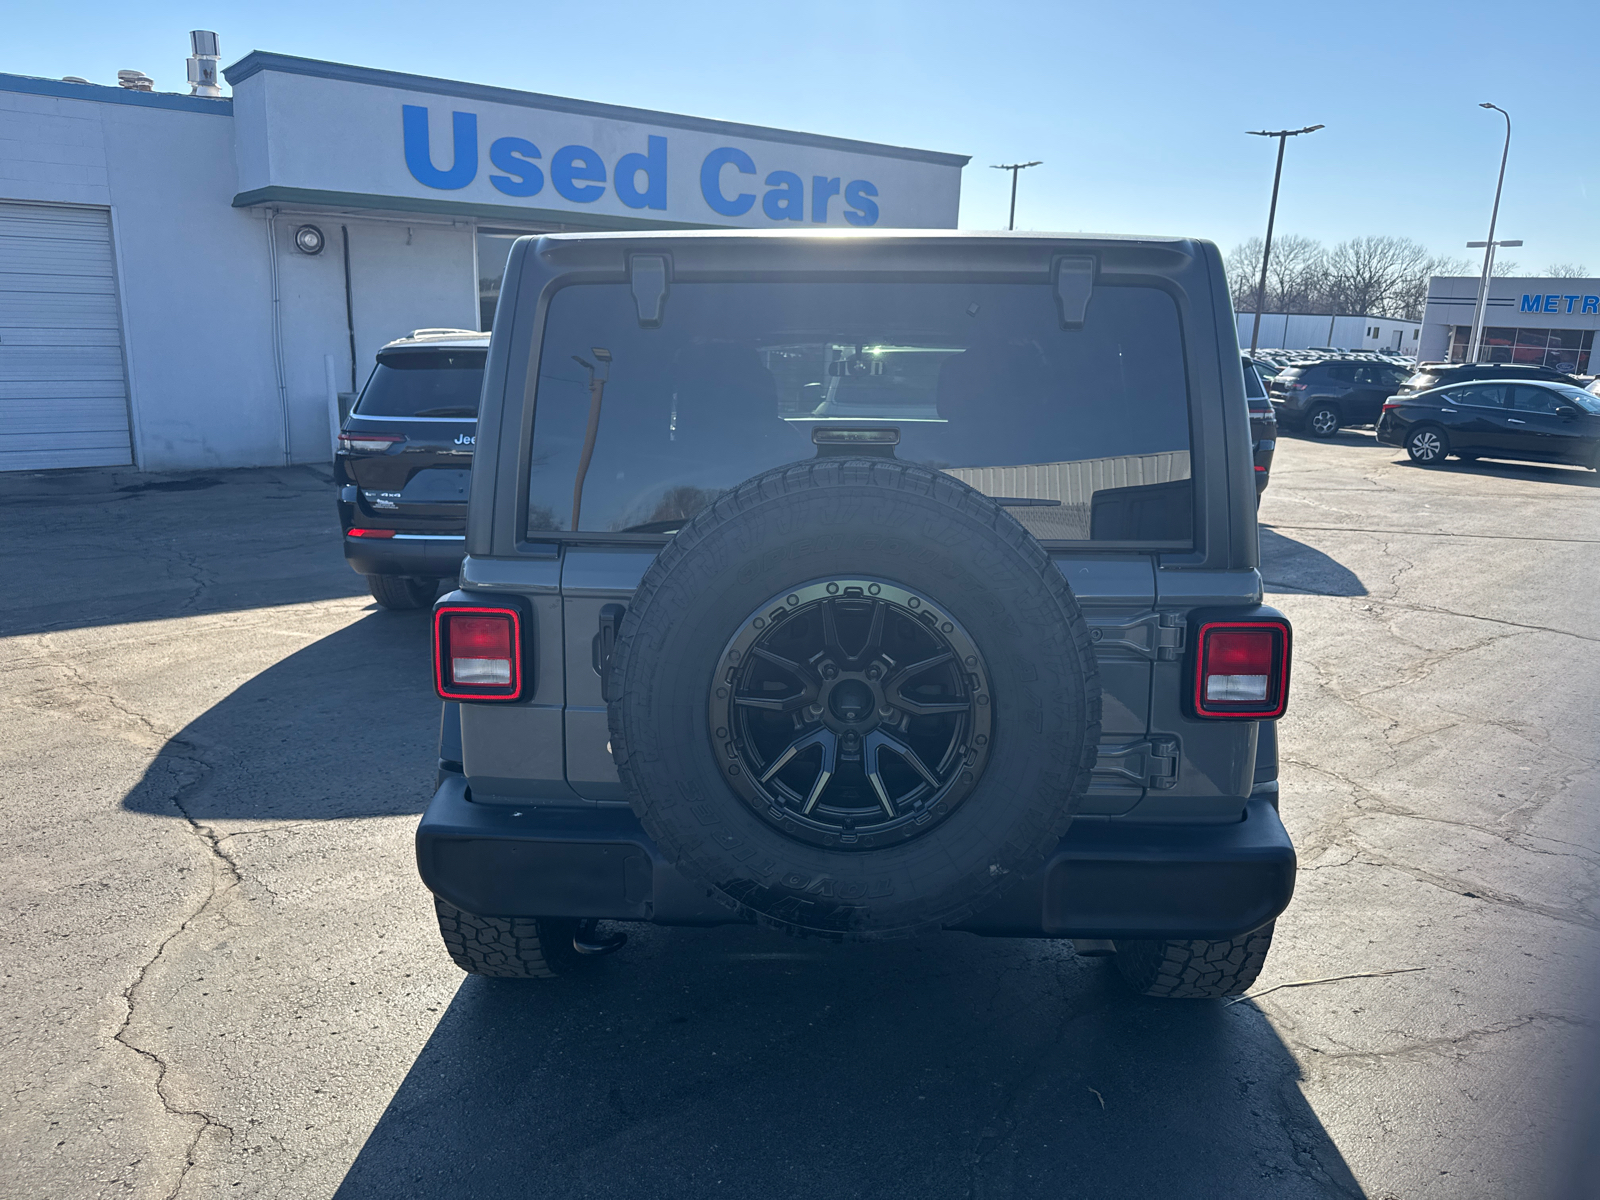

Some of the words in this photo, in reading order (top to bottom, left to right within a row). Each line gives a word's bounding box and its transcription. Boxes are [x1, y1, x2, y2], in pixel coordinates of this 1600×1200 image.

[402, 104, 667, 210] Used
[700, 147, 879, 226] Cars
[1520, 294, 1600, 315] METR
[736, 534, 844, 586] OPEN
[853, 533, 1022, 637] COUNTRY
[1015, 655, 1043, 734] A/T
[675, 779, 776, 878] TIRES
[779, 872, 894, 899] TOYO
